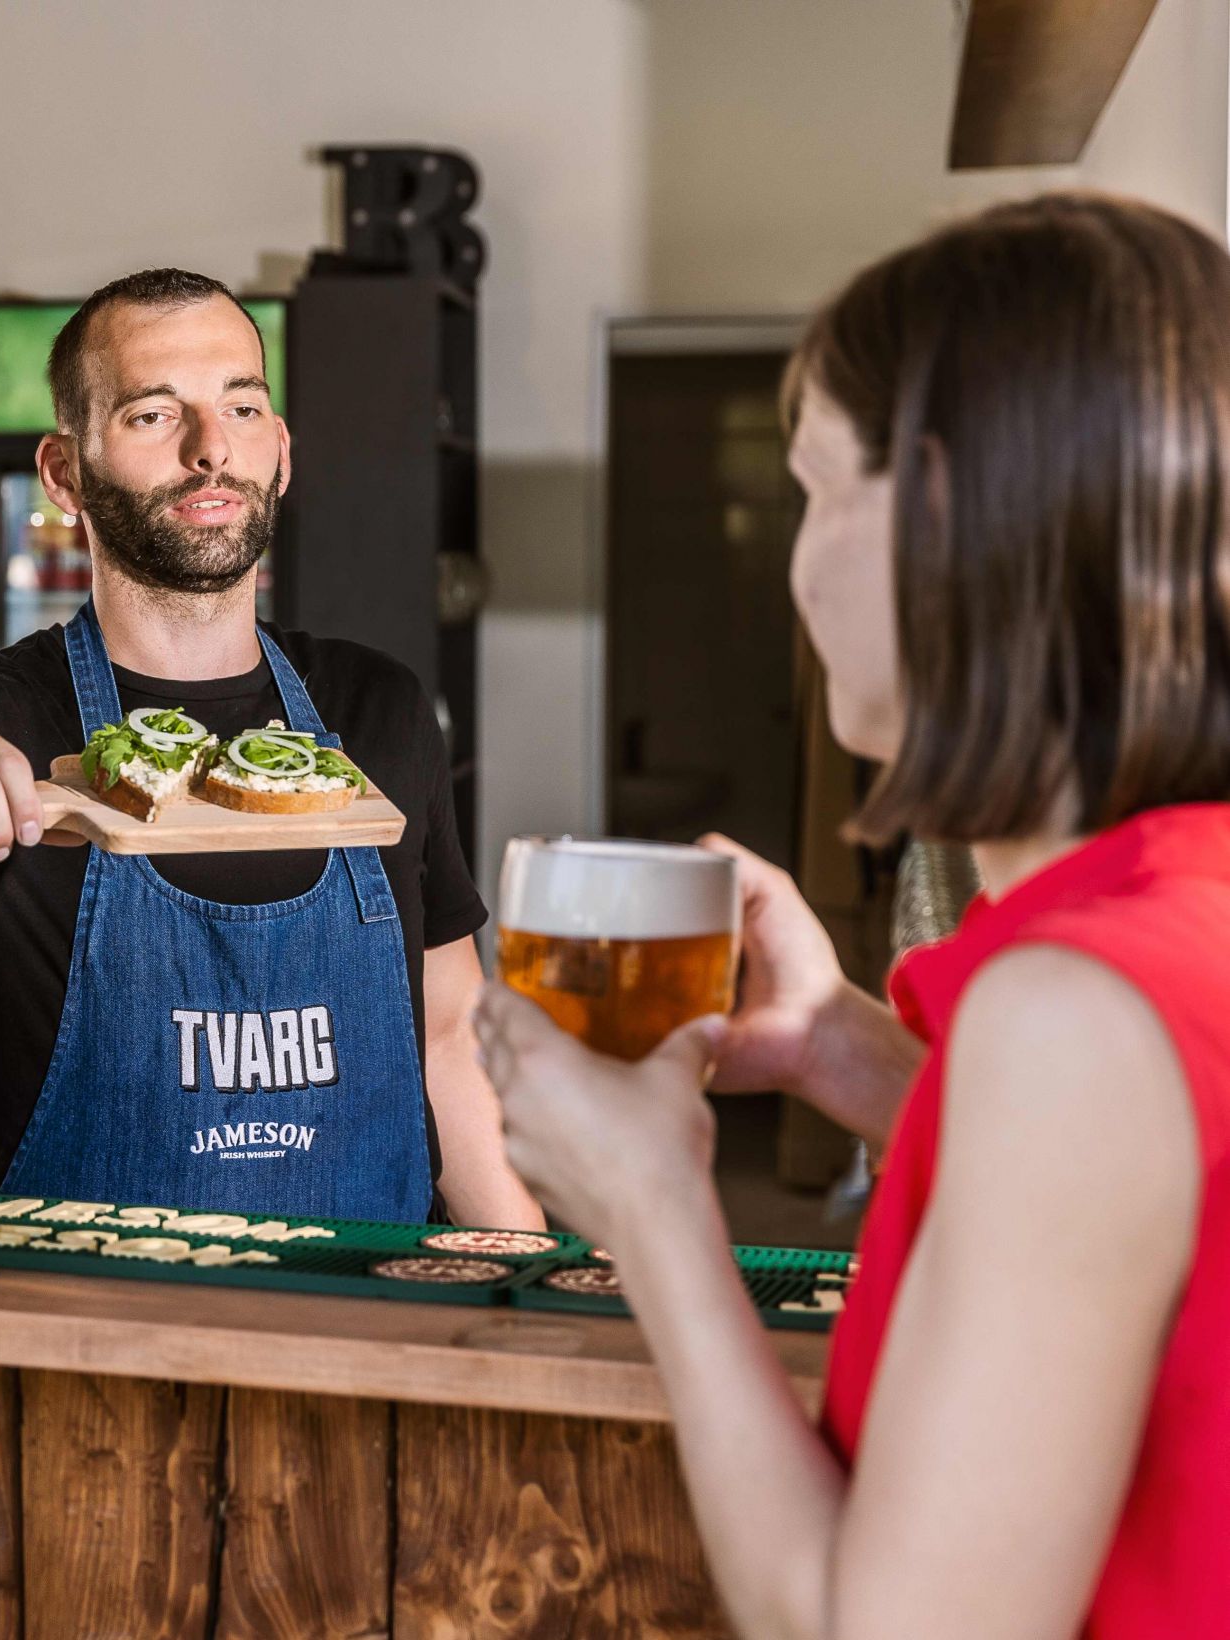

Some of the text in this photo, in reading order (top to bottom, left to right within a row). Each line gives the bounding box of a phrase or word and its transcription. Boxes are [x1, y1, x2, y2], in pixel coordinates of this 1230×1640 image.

[171, 1004, 339, 1093] TVARG
[189, 1121, 317, 1155] JAMESON
[220, 1149, 287, 1160] IRISH WHISKEY
